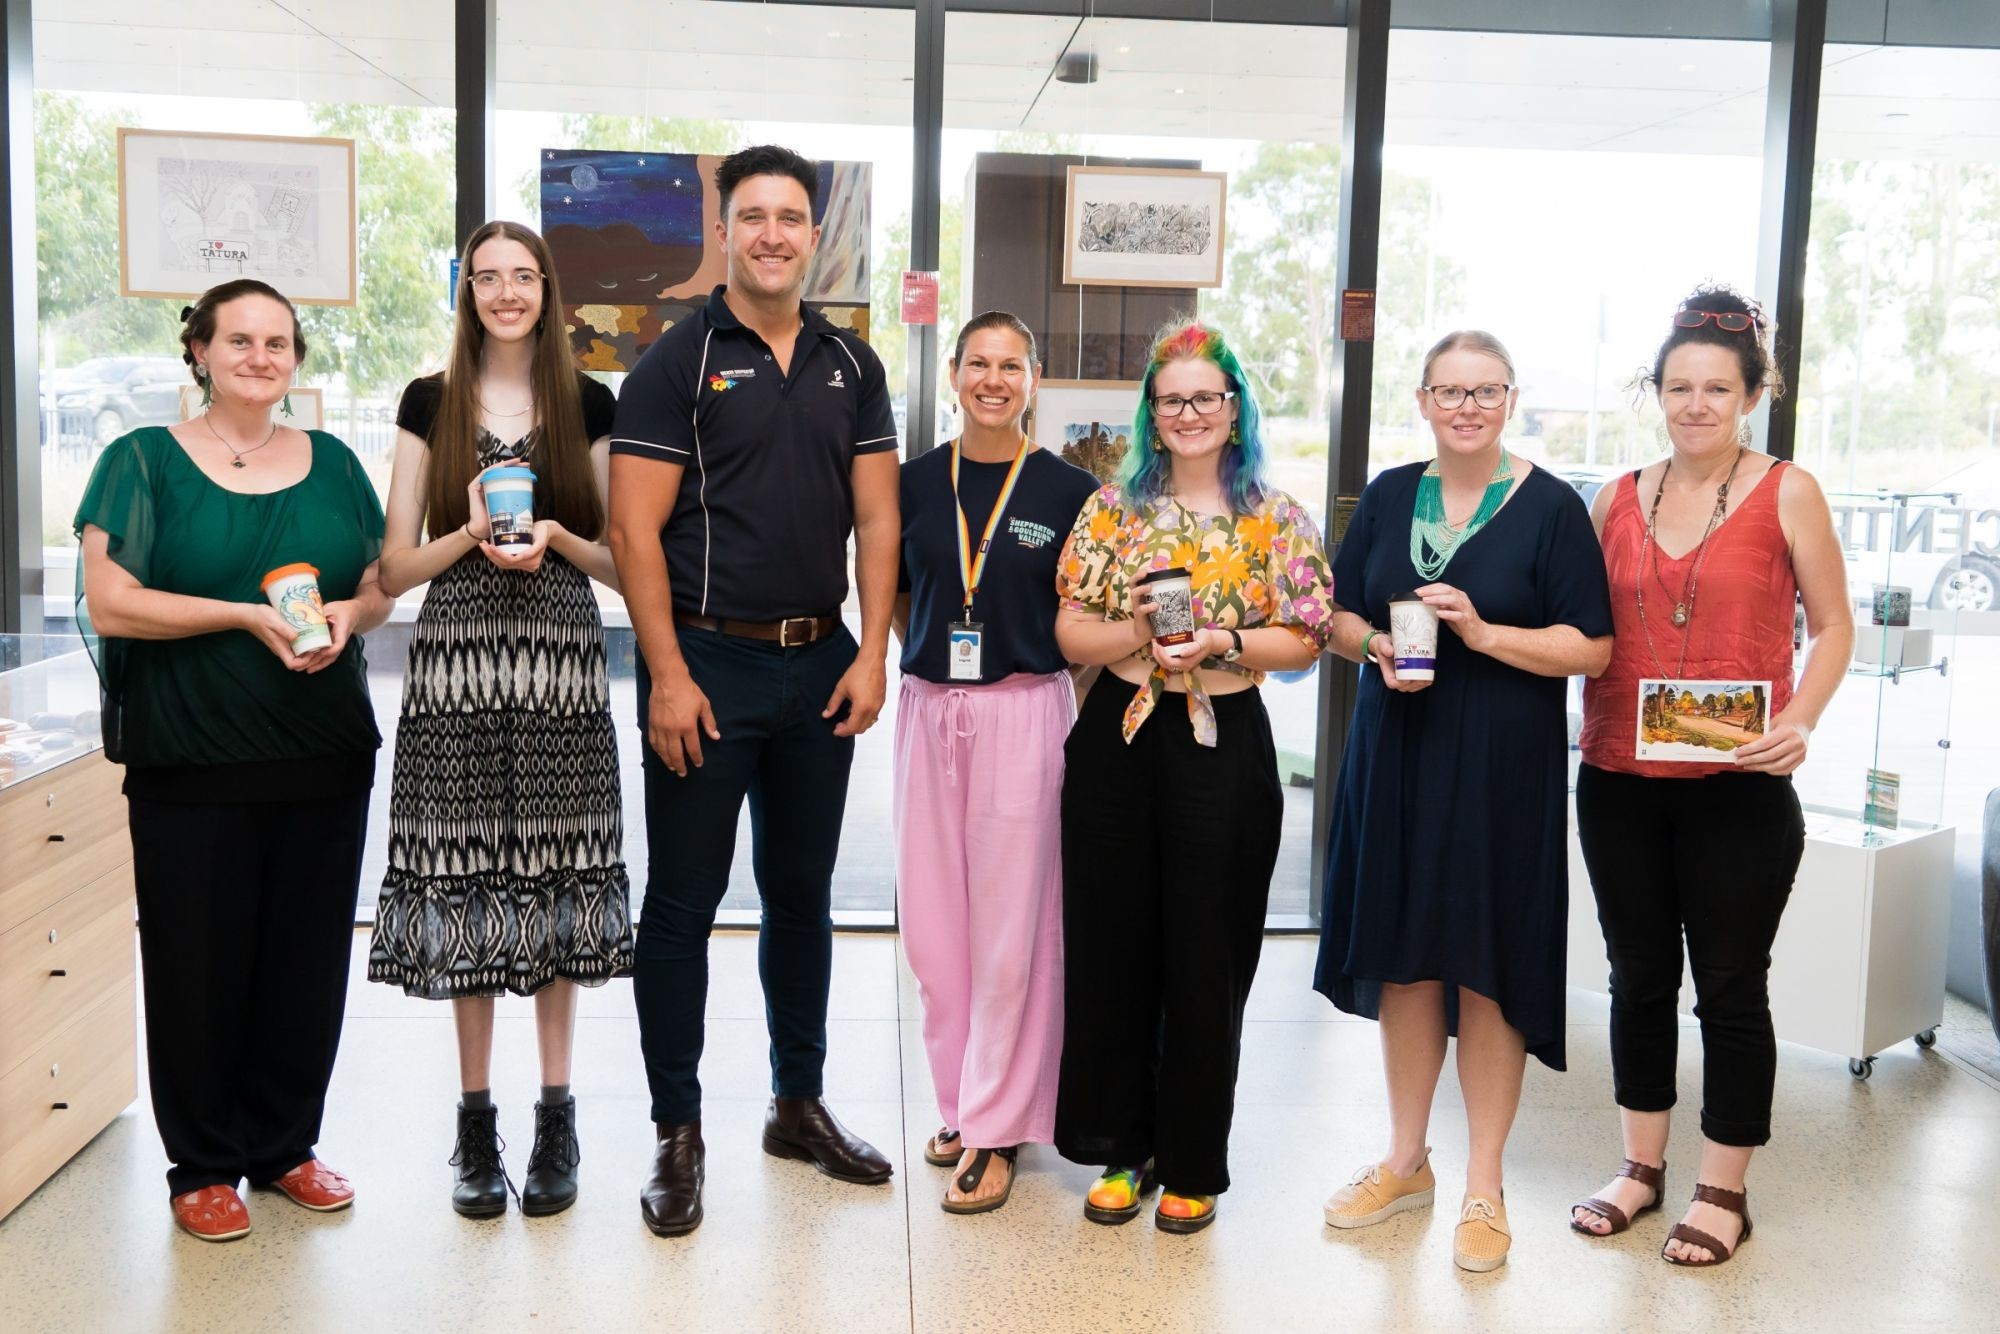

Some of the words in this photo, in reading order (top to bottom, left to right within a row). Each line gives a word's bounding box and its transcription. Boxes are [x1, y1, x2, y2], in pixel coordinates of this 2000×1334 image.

[200, 249, 248, 260] TATURA
[1010, 519, 1056, 538] SHEPPARTON
[1014, 527, 1051, 543] GOULBURN
[1018, 533, 1045, 547] VALLEY
